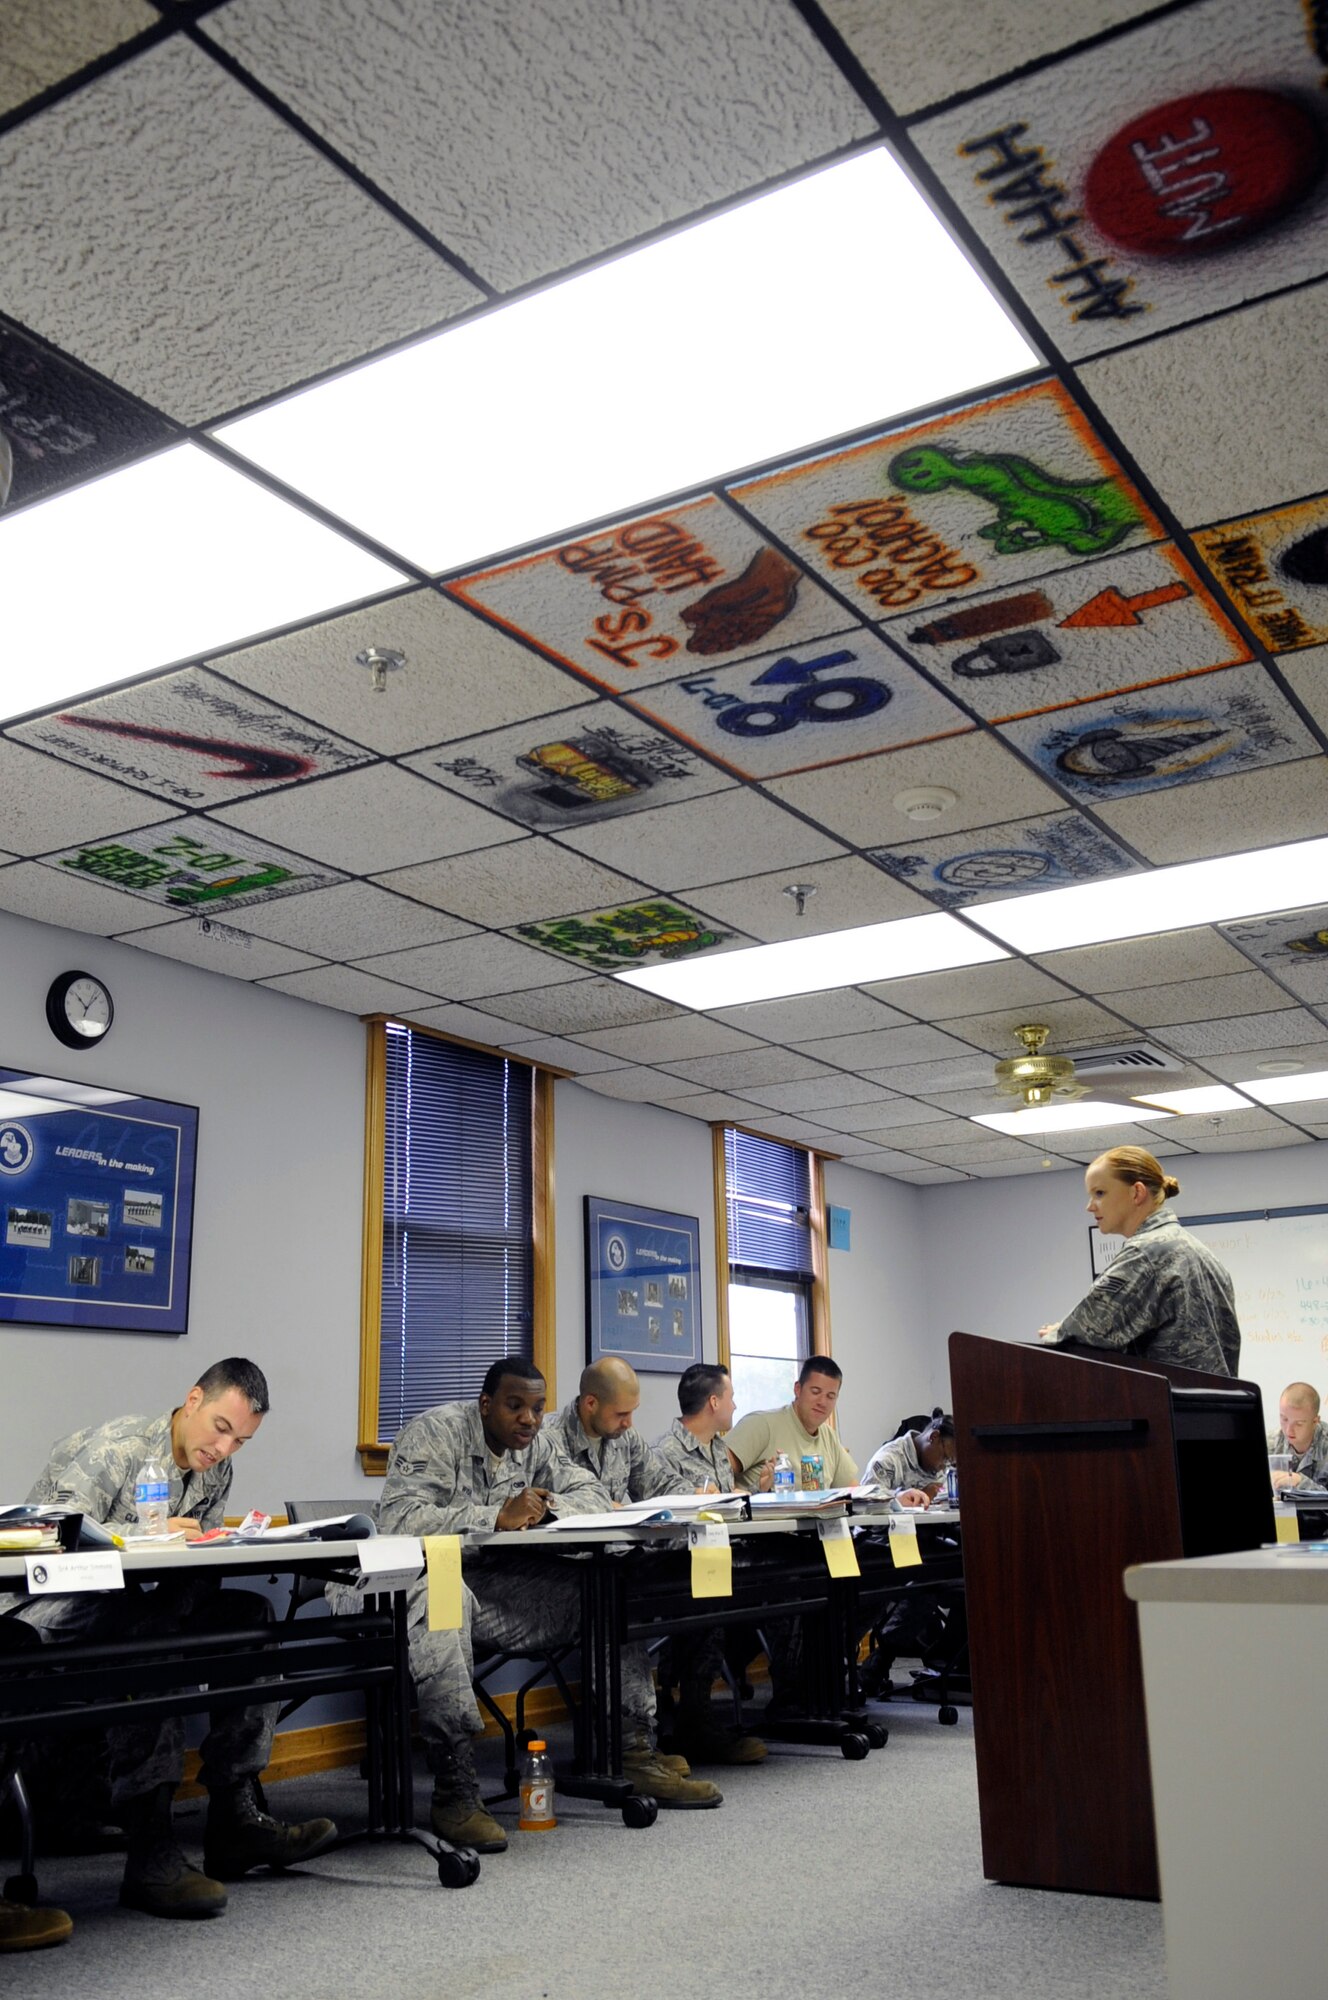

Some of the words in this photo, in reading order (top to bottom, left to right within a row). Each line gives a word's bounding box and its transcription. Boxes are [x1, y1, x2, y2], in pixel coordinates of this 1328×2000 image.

[1132, 117, 1243, 240] MUTE
[958, 120, 1151, 322] AH-HAH
[619, 520, 725, 594] HAND
[804, 520, 880, 569] COO
[555, 543, 658, 606] PIMP
[858, 568, 921, 609] COO
[153, 836, 247, 871] 10-2
[55, 1145, 103, 1162] LEADERS
[98, 1158, 107, 1167] in
[108, 1158, 124, 1169] the
[125, 1162, 155, 1175] making
